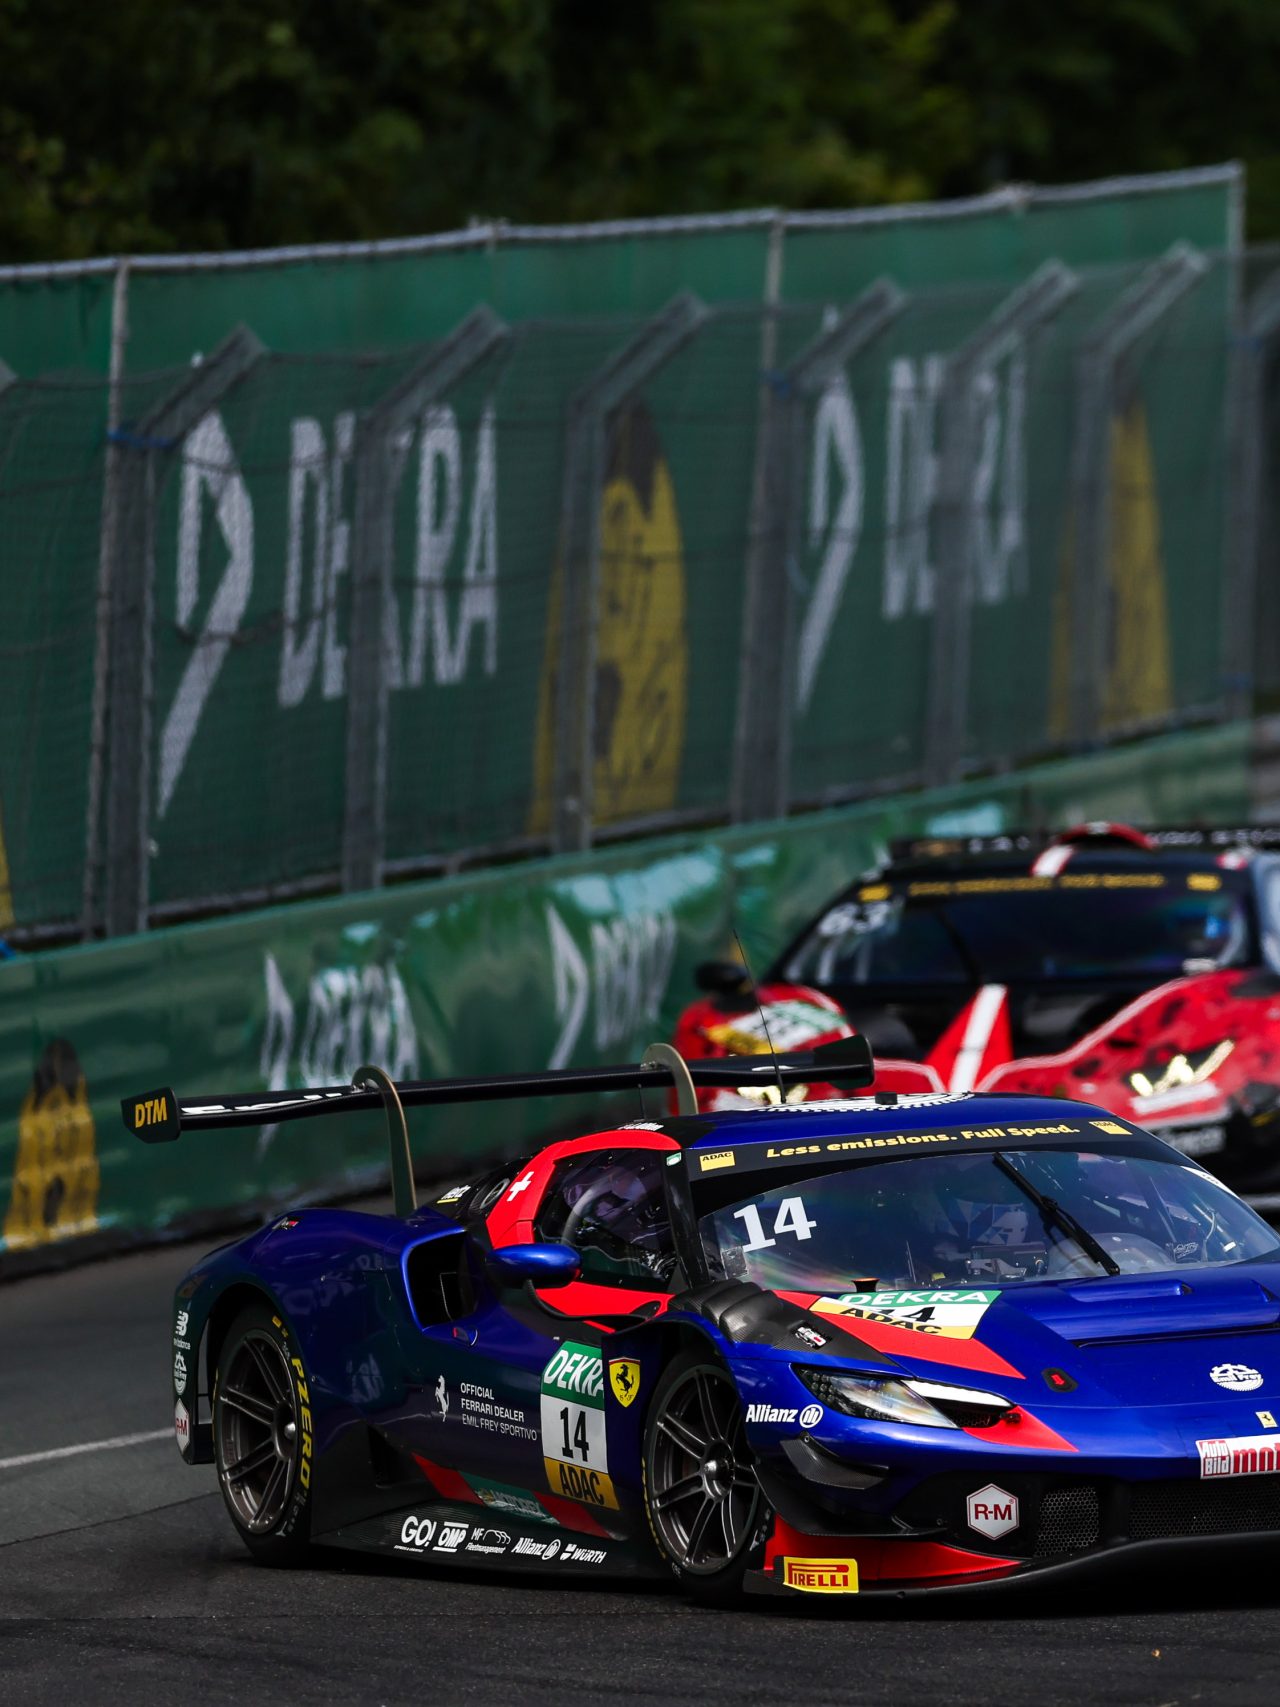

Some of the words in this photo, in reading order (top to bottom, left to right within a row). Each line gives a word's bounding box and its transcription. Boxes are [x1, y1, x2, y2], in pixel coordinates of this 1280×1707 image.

[135, 1097, 168, 1128] DTM
[767, 1144, 821, 1158] Less
[827, 1132, 957, 1151] emissions.
[961, 1127, 1005, 1140] Full
[1007, 1124, 1081, 1137] Speed.
[702, 1152, 732, 1162] ADAC
[733, 1196, 817, 1252] 14
[841, 1290, 990, 1306] DEKRA
[840, 1307, 942, 1334] ADAC
[460, 1382, 495, 1400] OFFICIAL
[461, 1398, 494, 1416] FERRARI
[494, 1405, 525, 1423] DEALER
[745, 1403, 798, 1423] Allianz
[462, 1413, 480, 1429] EMIL
[480, 1417, 500, 1434] FREY
[500, 1420, 538, 1441] SPORTIVO
[560, 1406, 590, 1463] 14
[1205, 1457, 1230, 1475] Bild
[558, 1463, 605, 1505] ADAC
[974, 1504, 1012, 1521] R-M
[401, 1516, 437, 1547] GO!
[438, 1527, 467, 1548] OMP
[471, 1527, 485, 1541] MF
[511, 1537, 548, 1556] Allianz
[570, 1549, 607, 1564] WÜRTH
[788, 1563, 850, 1587] PIRELLI
